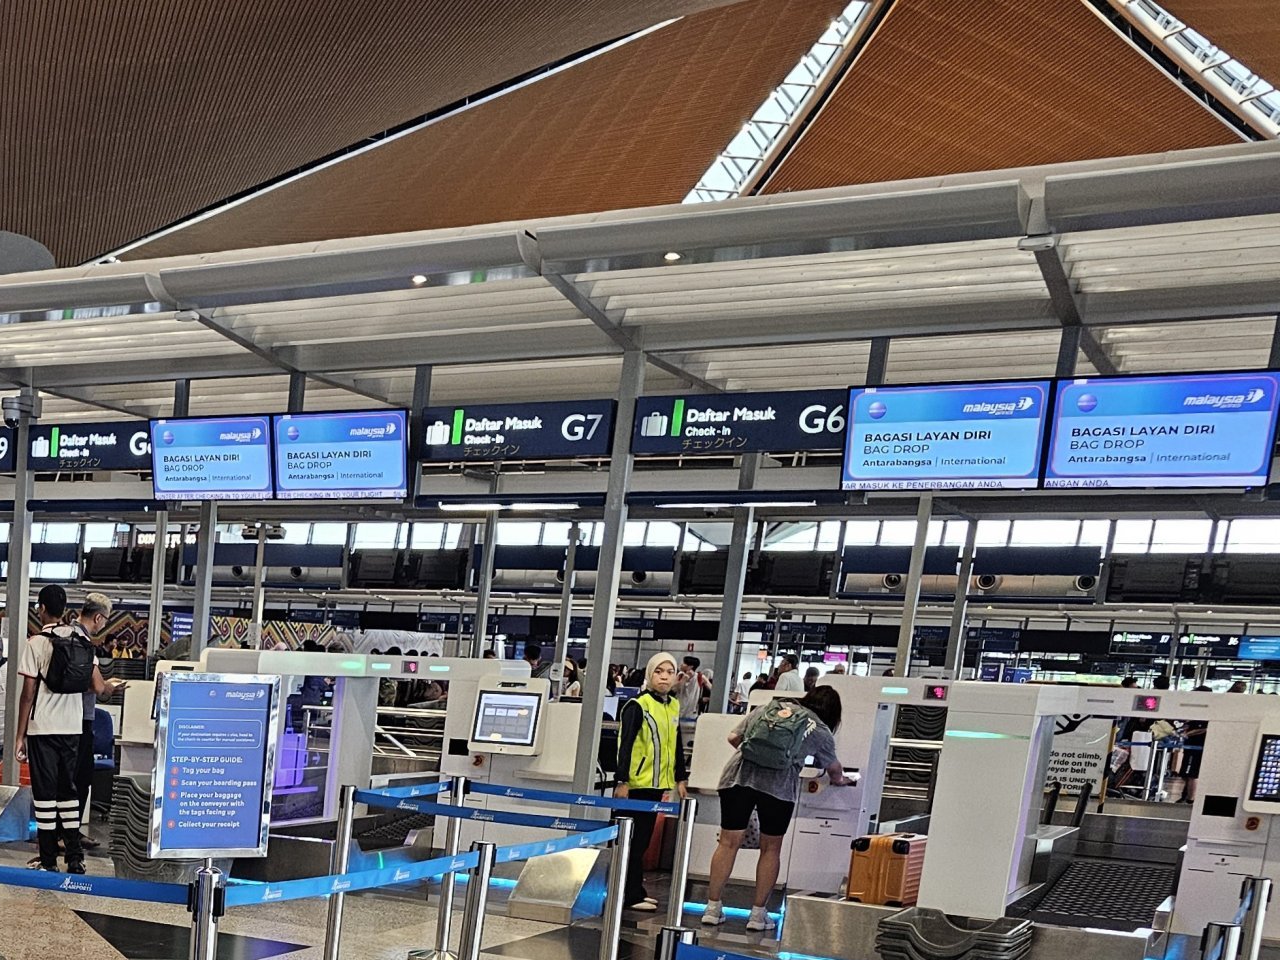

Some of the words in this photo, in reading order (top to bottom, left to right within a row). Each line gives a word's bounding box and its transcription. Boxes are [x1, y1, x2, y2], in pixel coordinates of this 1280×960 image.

[1183, 394, 1244, 408] malaysia
[962, 402, 1016, 415] malaysia
[686, 408, 731, 423] Daftar
[732, 407, 776, 421] Masuk
[798, 404, 845, 434] G6
[349, 425, 386, 438] malaysia
[464, 418, 504, 432] Daftar
[505, 416, 543, 430] Masuk
[561, 414, 604, 441] G7
[1071, 427, 1125, 437] BAGASI
[1130, 426, 1179, 436] LAYAN
[1183, 425, 1215, 435] DIRI
[220, 429, 251, 441] malaysia
[864, 432, 913, 443] BAGASI
[916, 431, 960, 441] LAYAN
[963, 430, 992, 440] DIRI
[59, 434, 88, 447] Daftar
[88, 433, 117, 446] Masuk
[682, 436, 748, 450] チェックイン
[1070, 440, 1099, 450] BAG
[1103, 439, 1145, 449] DROP
[464, 445, 520, 456] チェックイン
[863, 445, 890, 454] BAG
[893, 444, 930, 454] DROP
[163, 455, 193, 463] BAGASI
[194, 454, 221, 462] LAYAN
[223, 454, 240, 462] DIRI
[287, 451, 319, 459] BAGASI
[321, 450, 351, 459] LAYAN
[352, 450, 372, 458] DIRI
[1068, 453, 1147, 464] Antarabangsa
[1156, 452, 1231, 462] International
[307, 461, 332, 469] DROP
[862, 457, 933, 468] Antarabangsa
[940, 456, 1006, 466] International
[164, 464, 181, 472] BAG
[181, 464, 204, 472] DROP
[288, 472, 335, 480] Antarabangsa
[340, 471, 384, 479] International
[906, 481, 975, 489] PENERBANGAN
[220, 756, 243, 764] GUIDE:
[1077, 752, 1102, 760] climb,
[1084, 760, 1098, 768] the
[182, 767, 195, 775] Tag
[212, 767, 225, 775] bag
[1070, 766, 1087, 774] belt
[213, 779, 242, 787] boarding
[215, 792, 242, 800] baggage
[206, 808, 227, 816] facing
[201, 821, 217, 829] your
[217, 821, 240, 829] receipt
